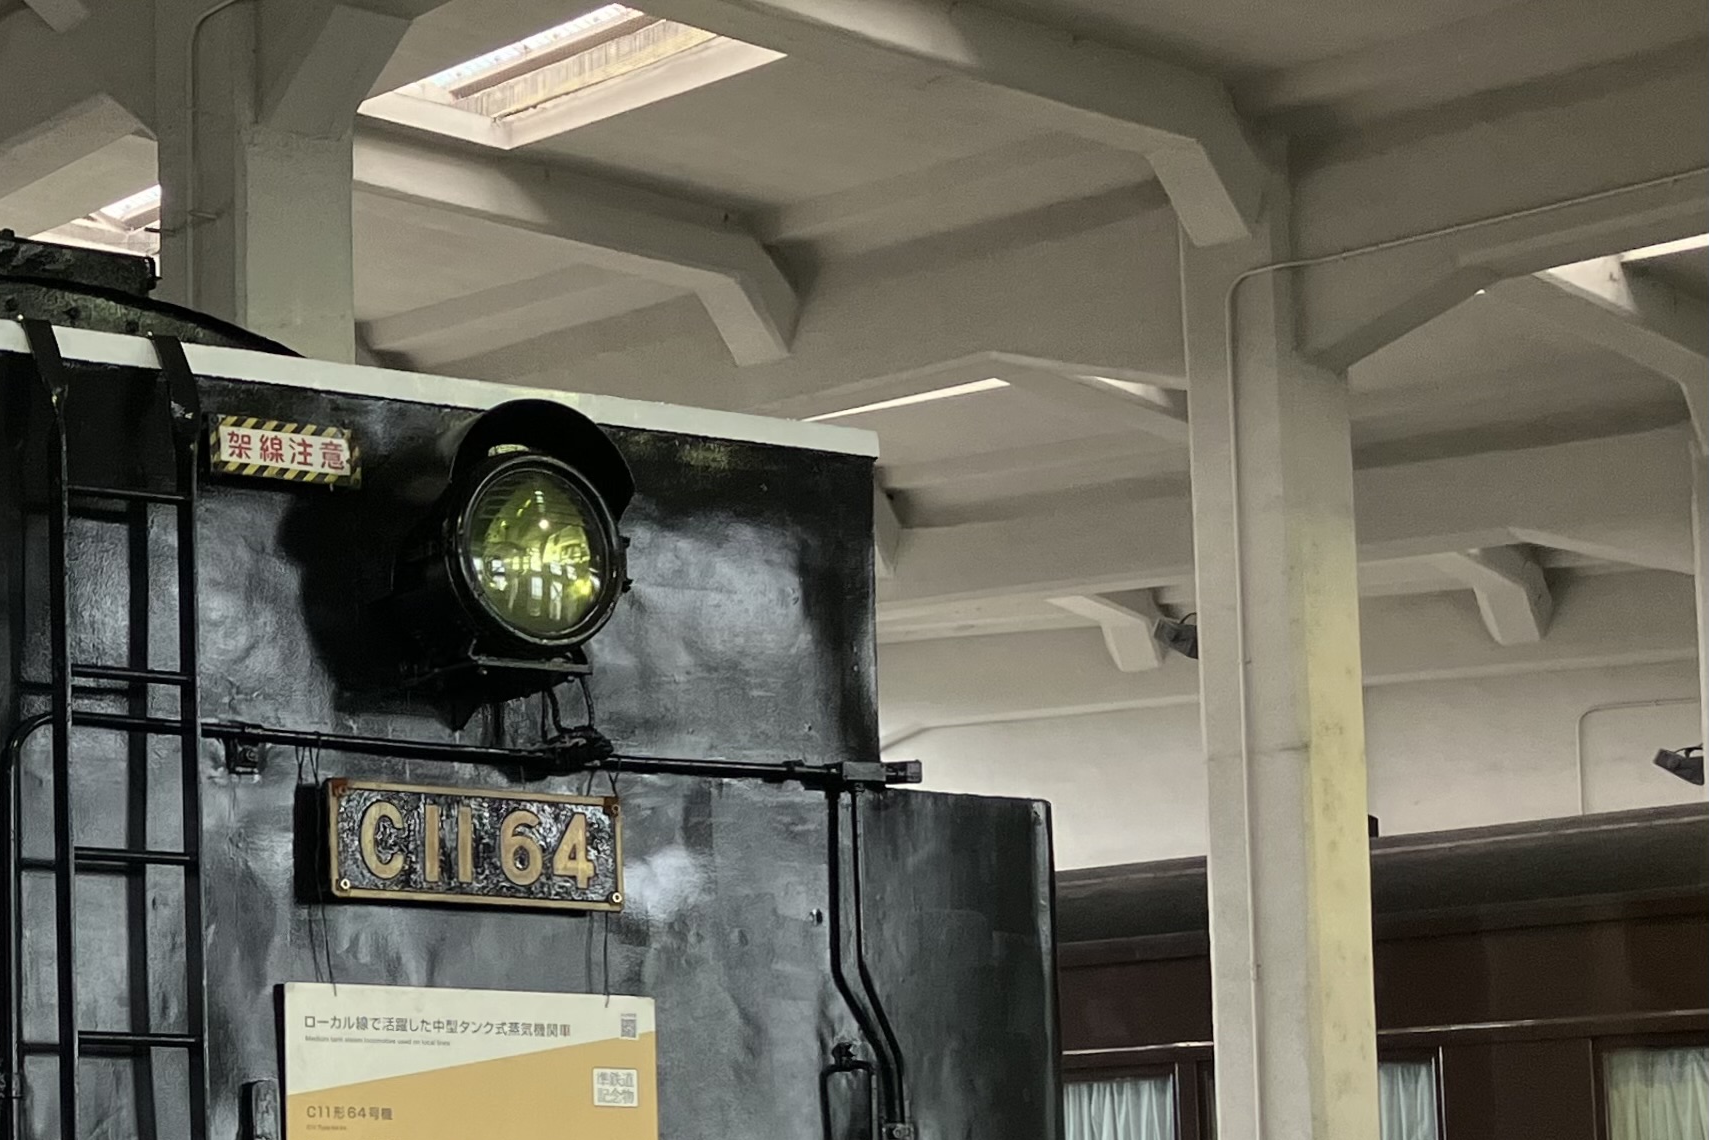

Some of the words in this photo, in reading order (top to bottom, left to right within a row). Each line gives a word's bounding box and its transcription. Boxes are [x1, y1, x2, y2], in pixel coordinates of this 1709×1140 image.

[227, 431, 345, 470] 架線注意
[304, 1015, 572, 1038] ローカル線で活躍した中型タンク式蒸気機関車
[597, 1088, 634, 1104] 記念物
